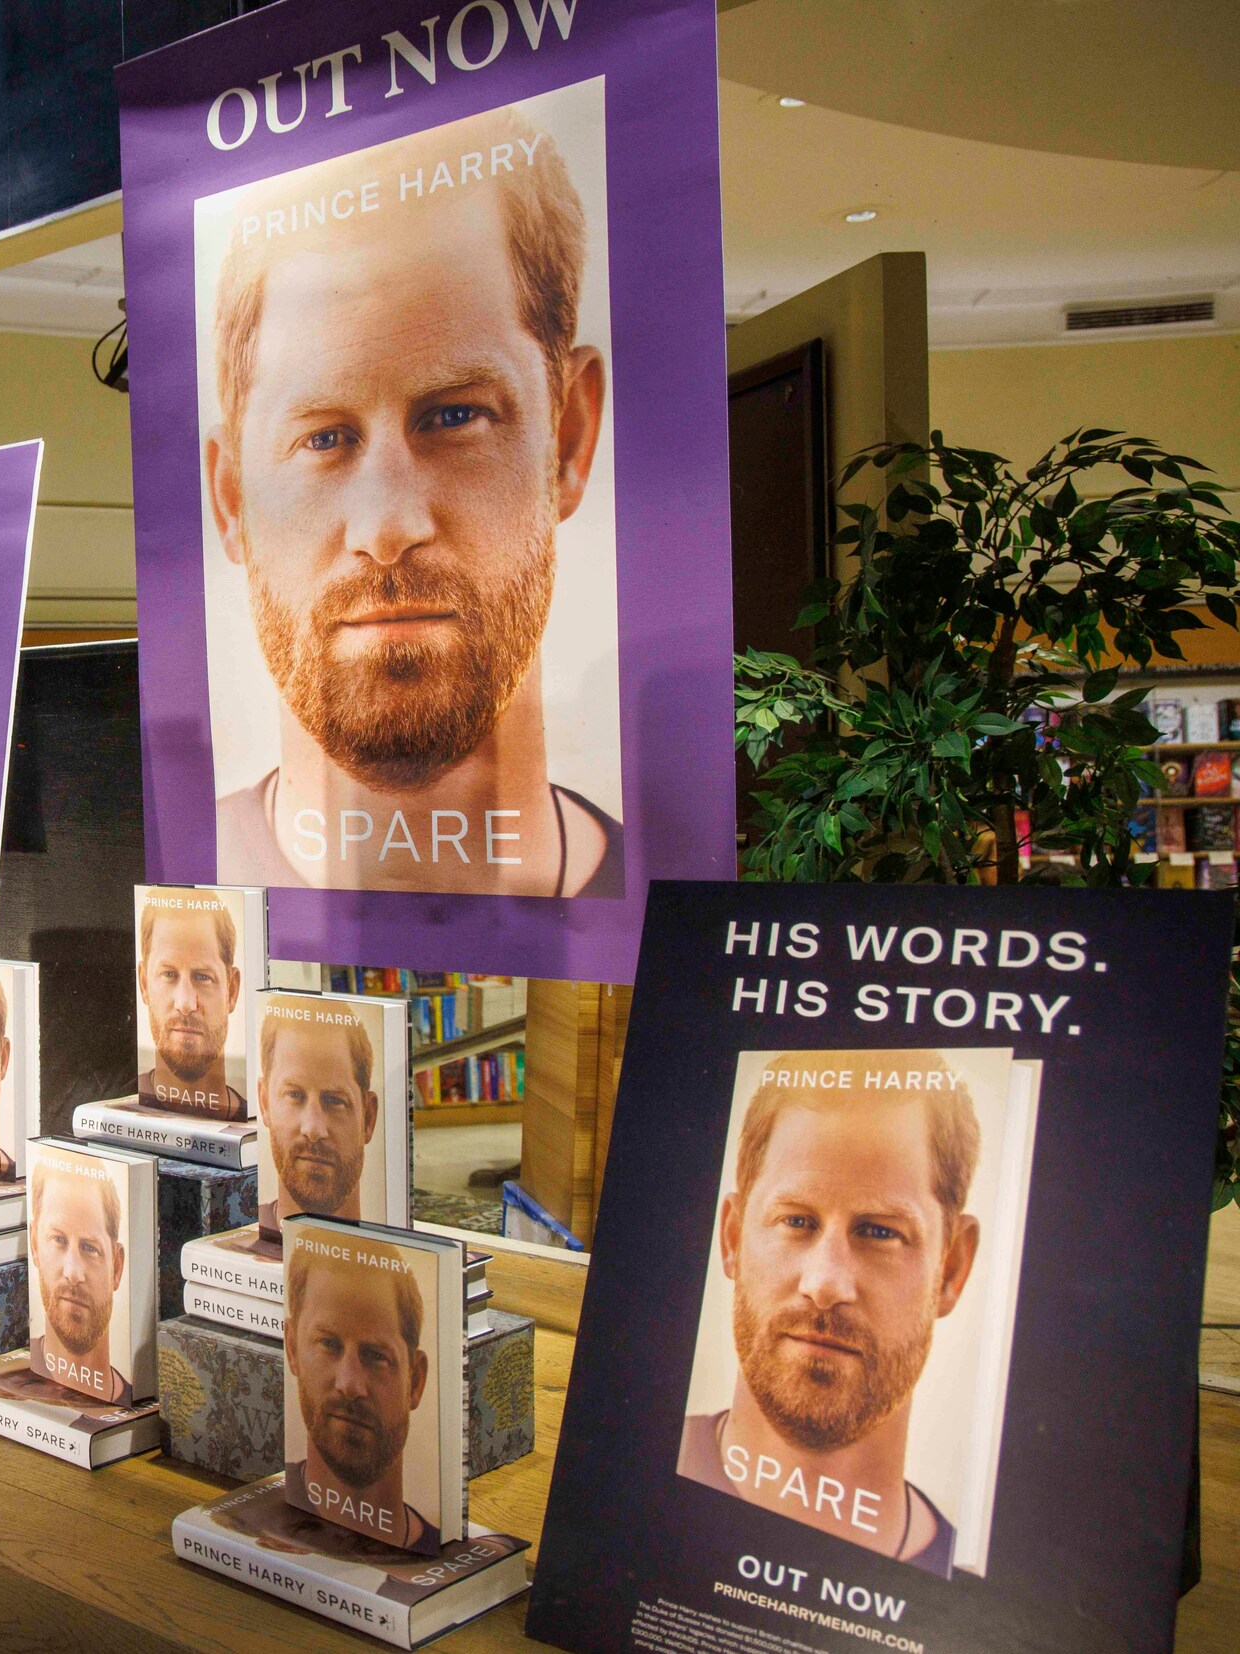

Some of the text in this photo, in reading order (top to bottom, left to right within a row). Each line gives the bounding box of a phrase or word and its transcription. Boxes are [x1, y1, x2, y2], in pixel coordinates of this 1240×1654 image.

[206, 0, 578, 151] OUT NOW
[241, 134, 544, 246] PRINCE HARRY
[292, 808, 523, 865] SPARE
[144, 896, 226, 912] PRINCE HARRY
[724, 919, 1108, 973] HIS WORDS.
[265, 1005, 361, 1027] PRINCE HARRY
[731, 977, 1082, 1036] HIS STORY.
[156, 1085, 220, 1111] SPARE
[761, 1068, 964, 1092] PRINCE HARRY
[81, 1118, 216, 1154] PRINCE HARRY SPARE
[75, 1165, 112, 1181] HARRY
[295, 1237, 410, 1275] PRINCE HARRY
[191, 1262, 284, 1295] PRINCE HAR
[194, 1298, 285, 1331] PRINCE HAR
[2, 1349, 30, 1364] HAR
[45, 1353, 104, 1391] SPARE
[26, 1426, 66, 1450] SPARE
[203, 1477, 286, 1518] PRINCE HARR
[307, 1482, 394, 1534] SPARE
[723, 1443, 884, 1534] SPARE
[183, 1537, 375, 1624] PRINCE HARRY SPARE
[410, 1545, 496, 1588] SPARE
[737, 1555, 906, 1622] OUT NOW
[714, 1581, 924, 1654] PRINCEHARRYMEMOIR.COM
